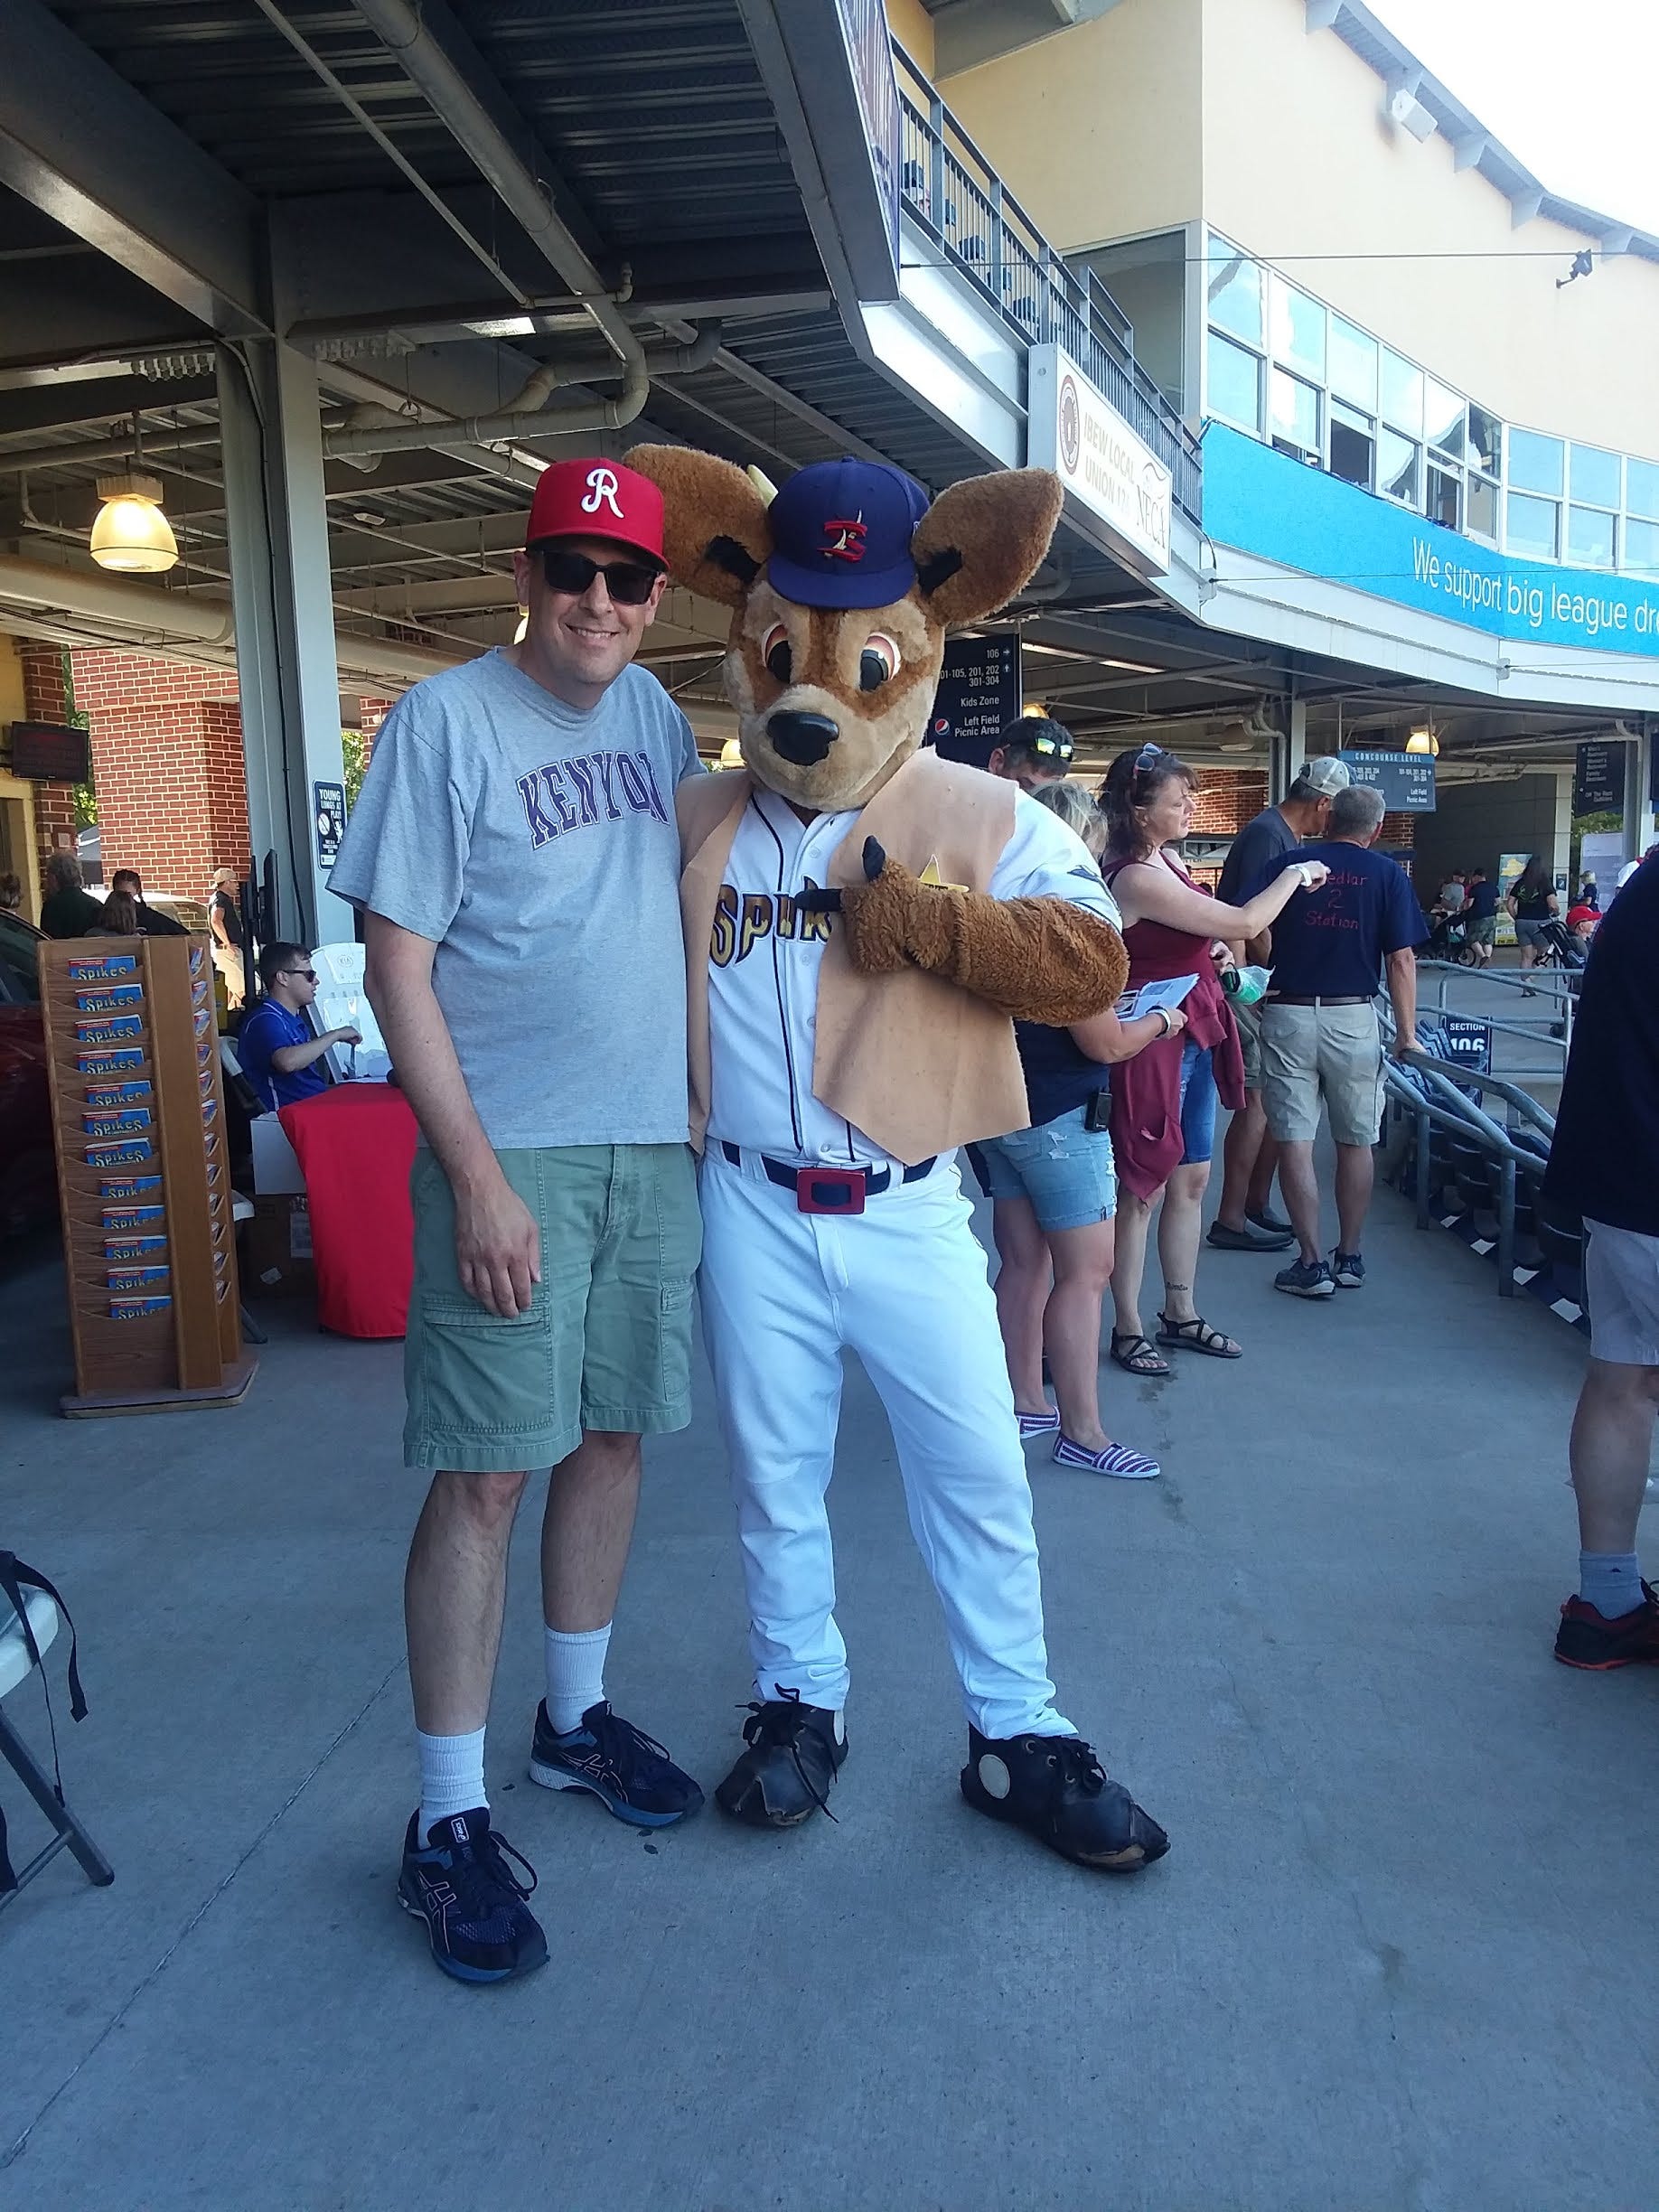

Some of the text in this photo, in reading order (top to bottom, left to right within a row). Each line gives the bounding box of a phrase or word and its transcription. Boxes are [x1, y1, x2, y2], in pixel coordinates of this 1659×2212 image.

[1110, 438, 1135, 484] LOCAL
[1085, 455, 1115, 504] UNION
[581, 468, 625, 519] R
[1412, 536, 1659, 634] We support big league dr
[940, 669, 967, 680] 01-105,
[986, 665, 999, 675] 202
[969, 676, 1000, 688] 301-304
[961, 696, 999, 708] Kids Zone
[964, 714, 1000, 726] Left Field
[954, 725, 1000, 737] Picnic Area
[1355, 753, 1421, 763] CONCOURSE LEVEL
[319, 788, 341, 801] YOUNG
[516, 750, 670, 850] KENYON
[1327, 870, 1368, 886] edlar
[1305, 910, 1359, 929] Station
[1449, 1022, 1486, 1031] SECTION
[1450, 1037, 1486, 1052] 106
